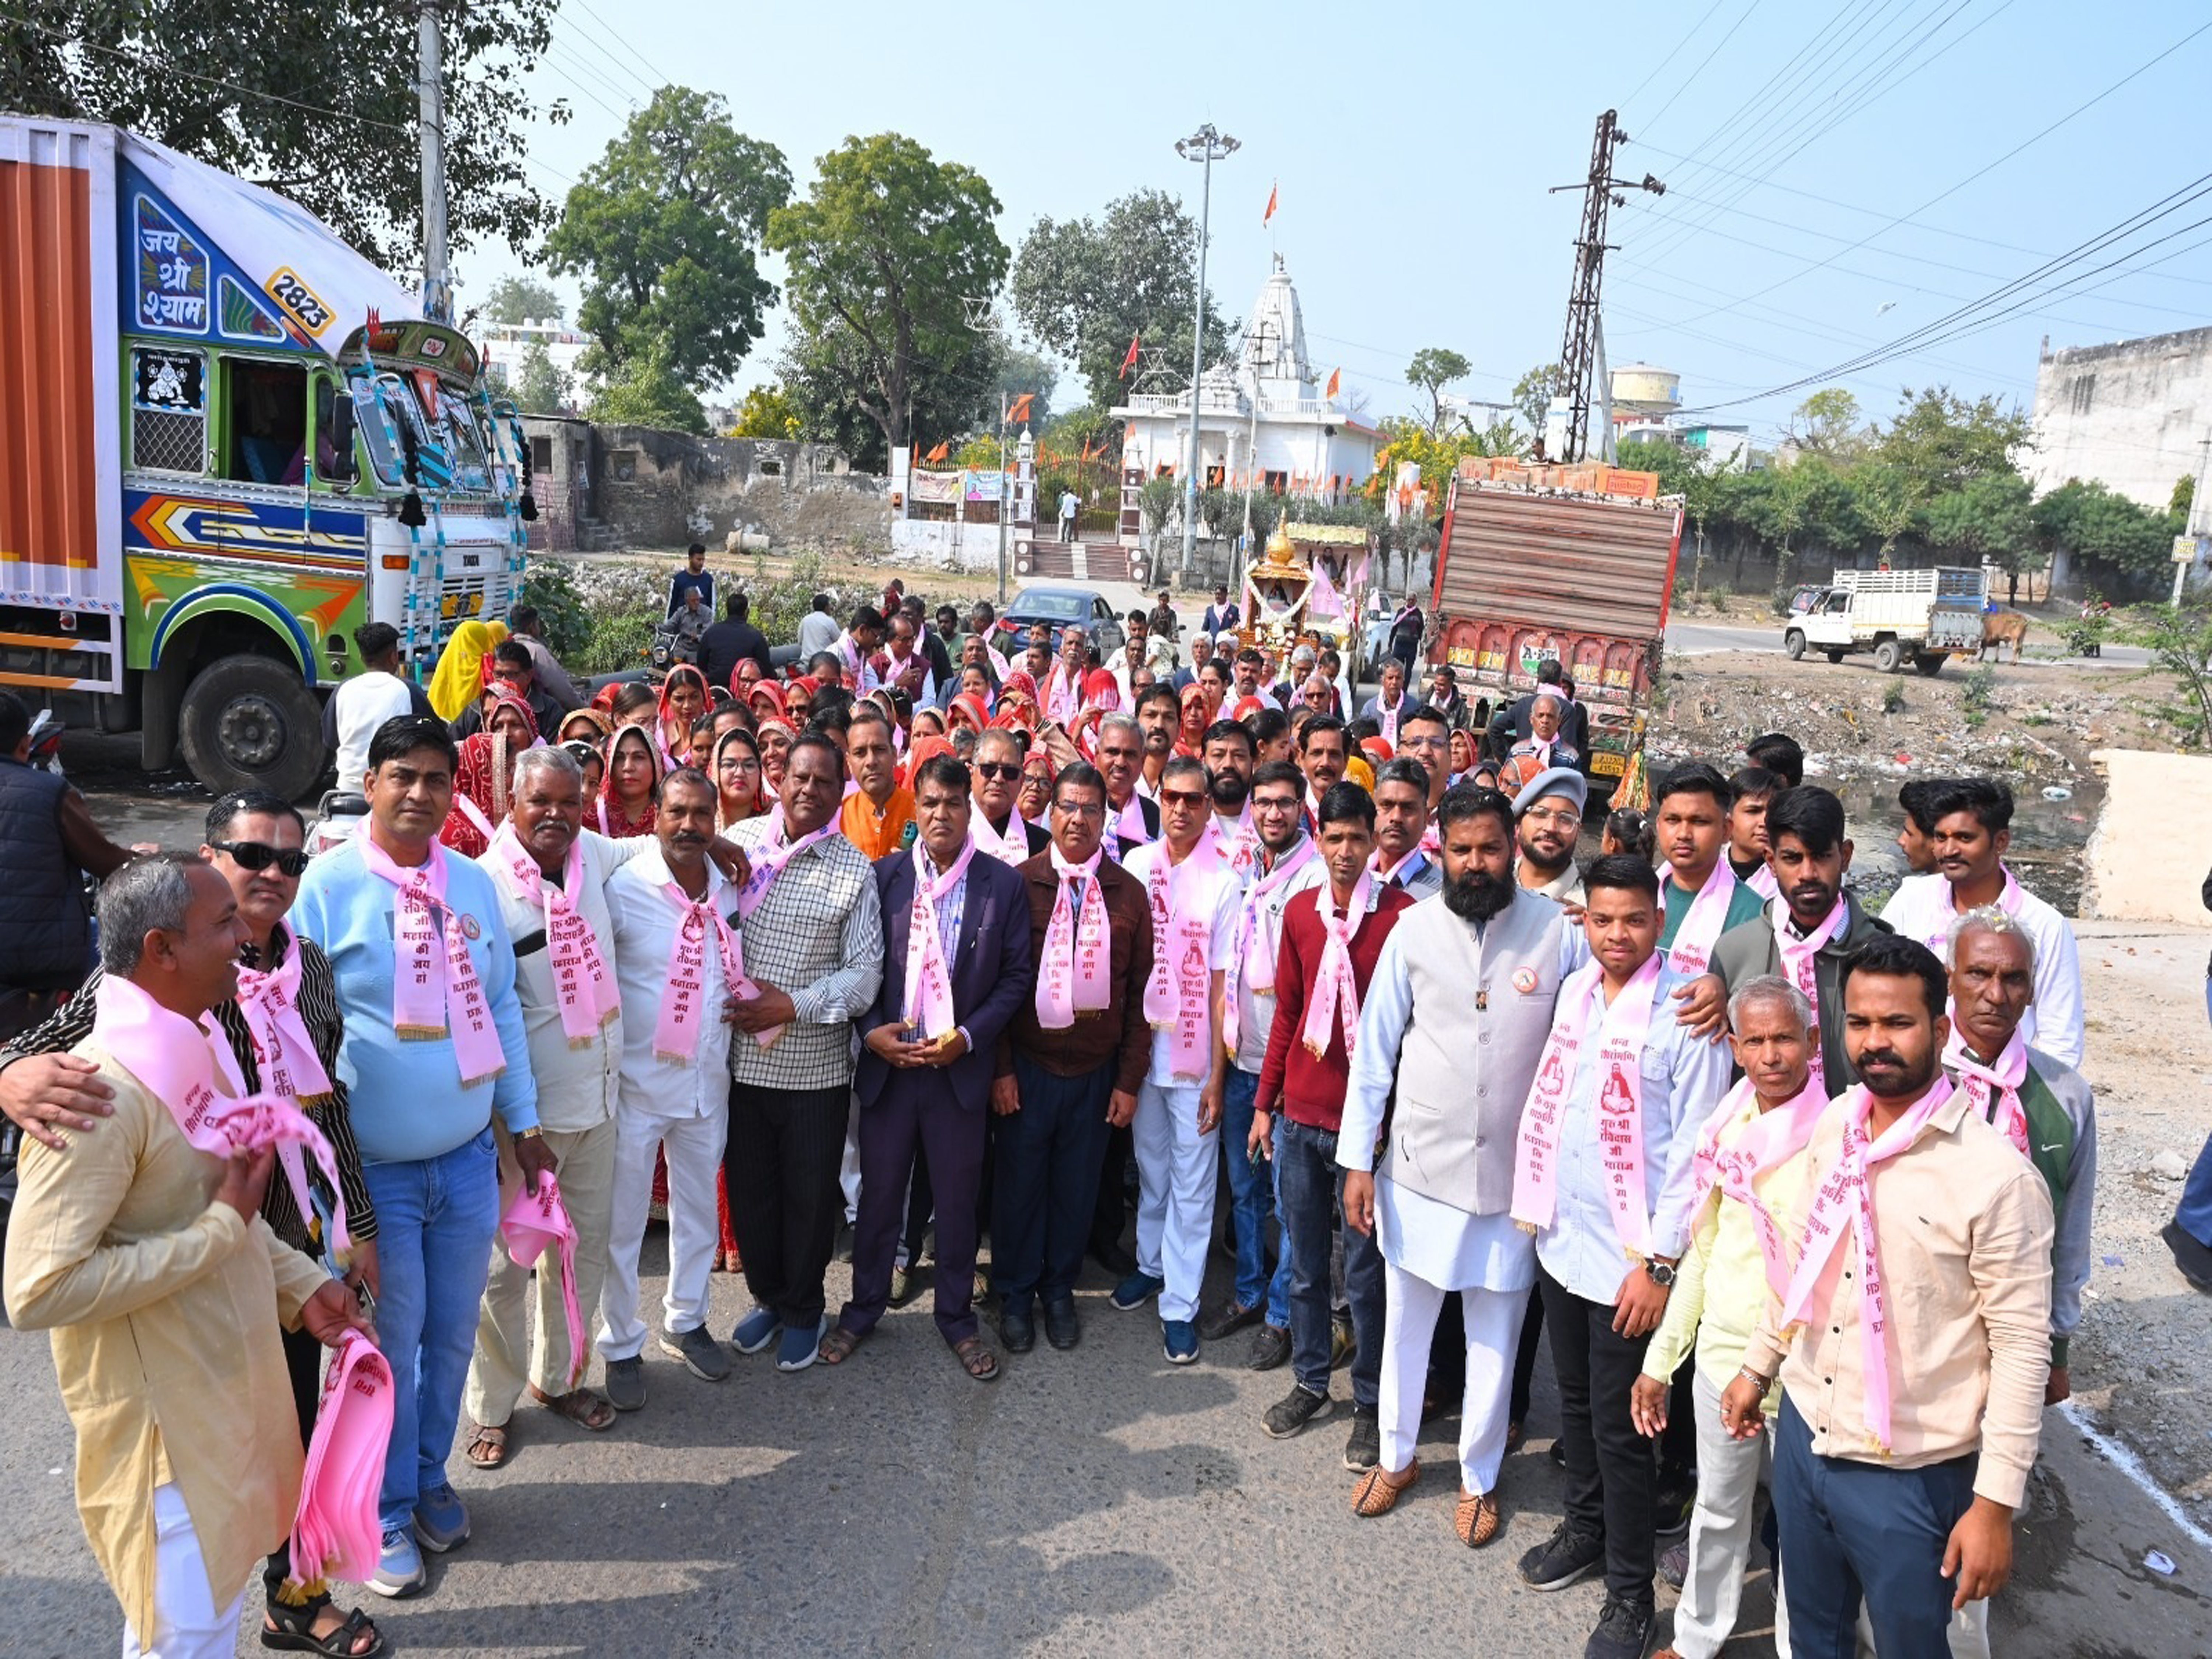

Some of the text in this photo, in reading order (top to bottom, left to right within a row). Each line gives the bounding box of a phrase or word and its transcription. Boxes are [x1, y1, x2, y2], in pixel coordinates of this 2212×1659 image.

[141, 229, 180, 254] जय
[159, 257, 191, 291] श्री
[273, 275, 329, 327] 2823
[144, 291, 204, 324] श्याम
[416, 943, 429, 954] की
[559, 943, 571, 953] जी
[413, 960, 430, 969] जय
[561, 968, 573, 979] की
[561, 982, 577, 992] जय
[673, 1003, 689, 1012] जय
[1617, 1119, 1630, 1130] श्री
[1609, 1146, 1622, 1157] जी
